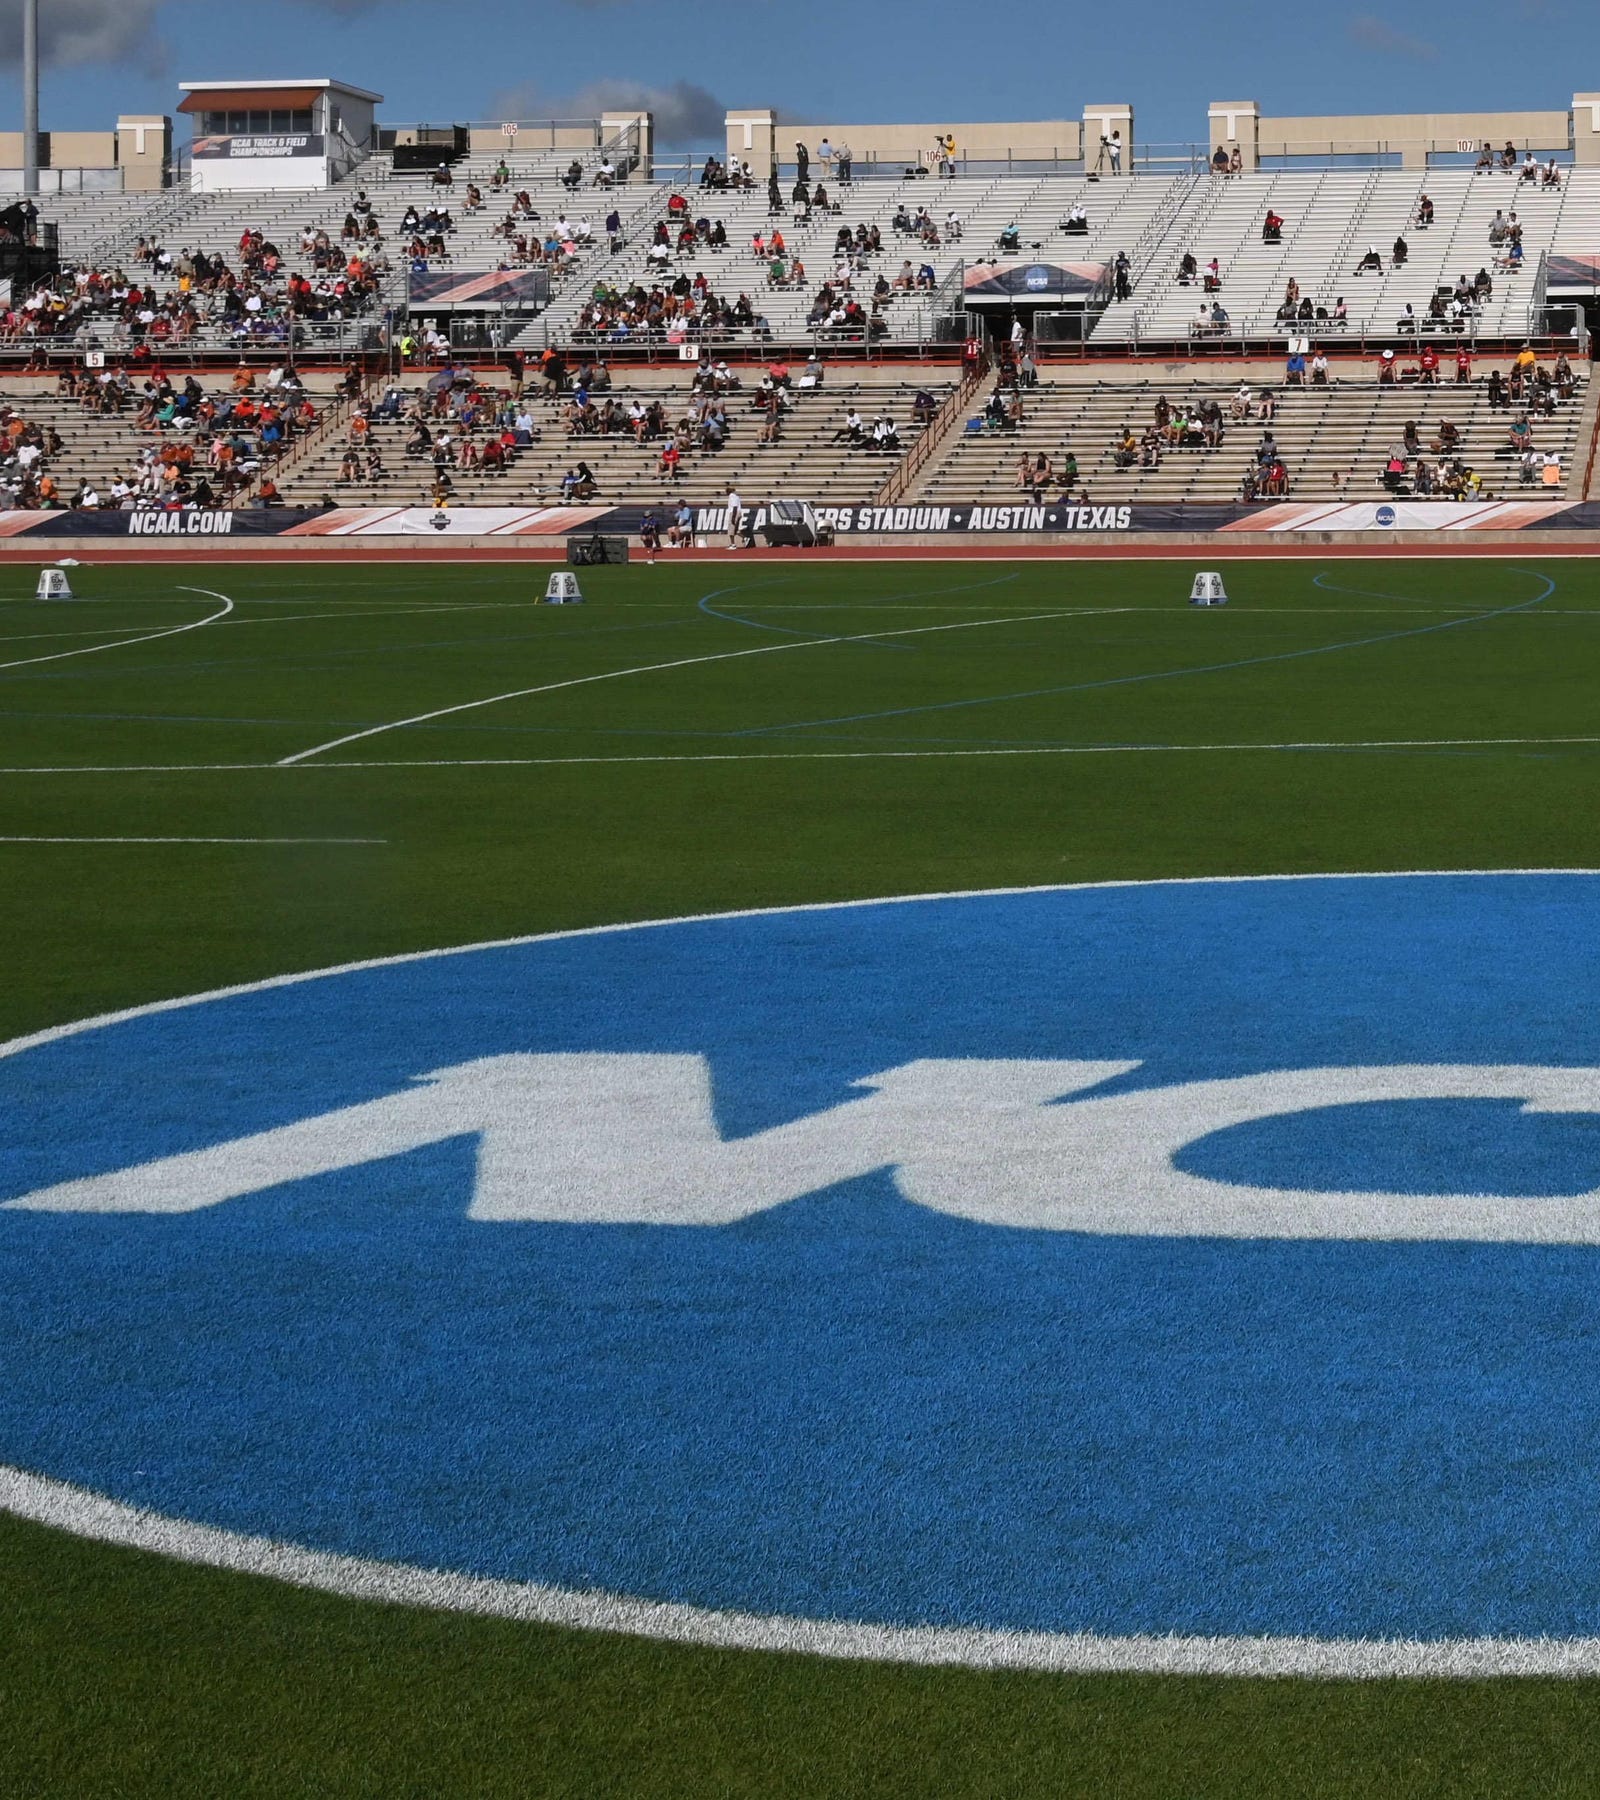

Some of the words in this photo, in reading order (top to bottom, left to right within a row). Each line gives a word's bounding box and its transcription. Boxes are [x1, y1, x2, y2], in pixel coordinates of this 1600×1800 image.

[503, 124, 517, 135] 105
[230, 138, 251, 147] NCAA
[254, 138, 278, 147] TRACK
[286, 137, 307, 147] FIELD
[1457, 140, 1473, 152] 107
[229, 147, 293, 157] CHAMPIONSHIPS
[926, 150, 941, 162] 106
[1295, 339, 1302, 352] 7
[685, 346, 692, 359] 6
[92, 353, 99, 366] 5
[128, 511, 233, 534] NCAA.COM
[697, 508, 750, 531] MIE
[857, 507, 951, 531] STADIUM
[967, 507, 1046, 530] AUSTIN
[1065, 506, 1132, 529] TEXAS
